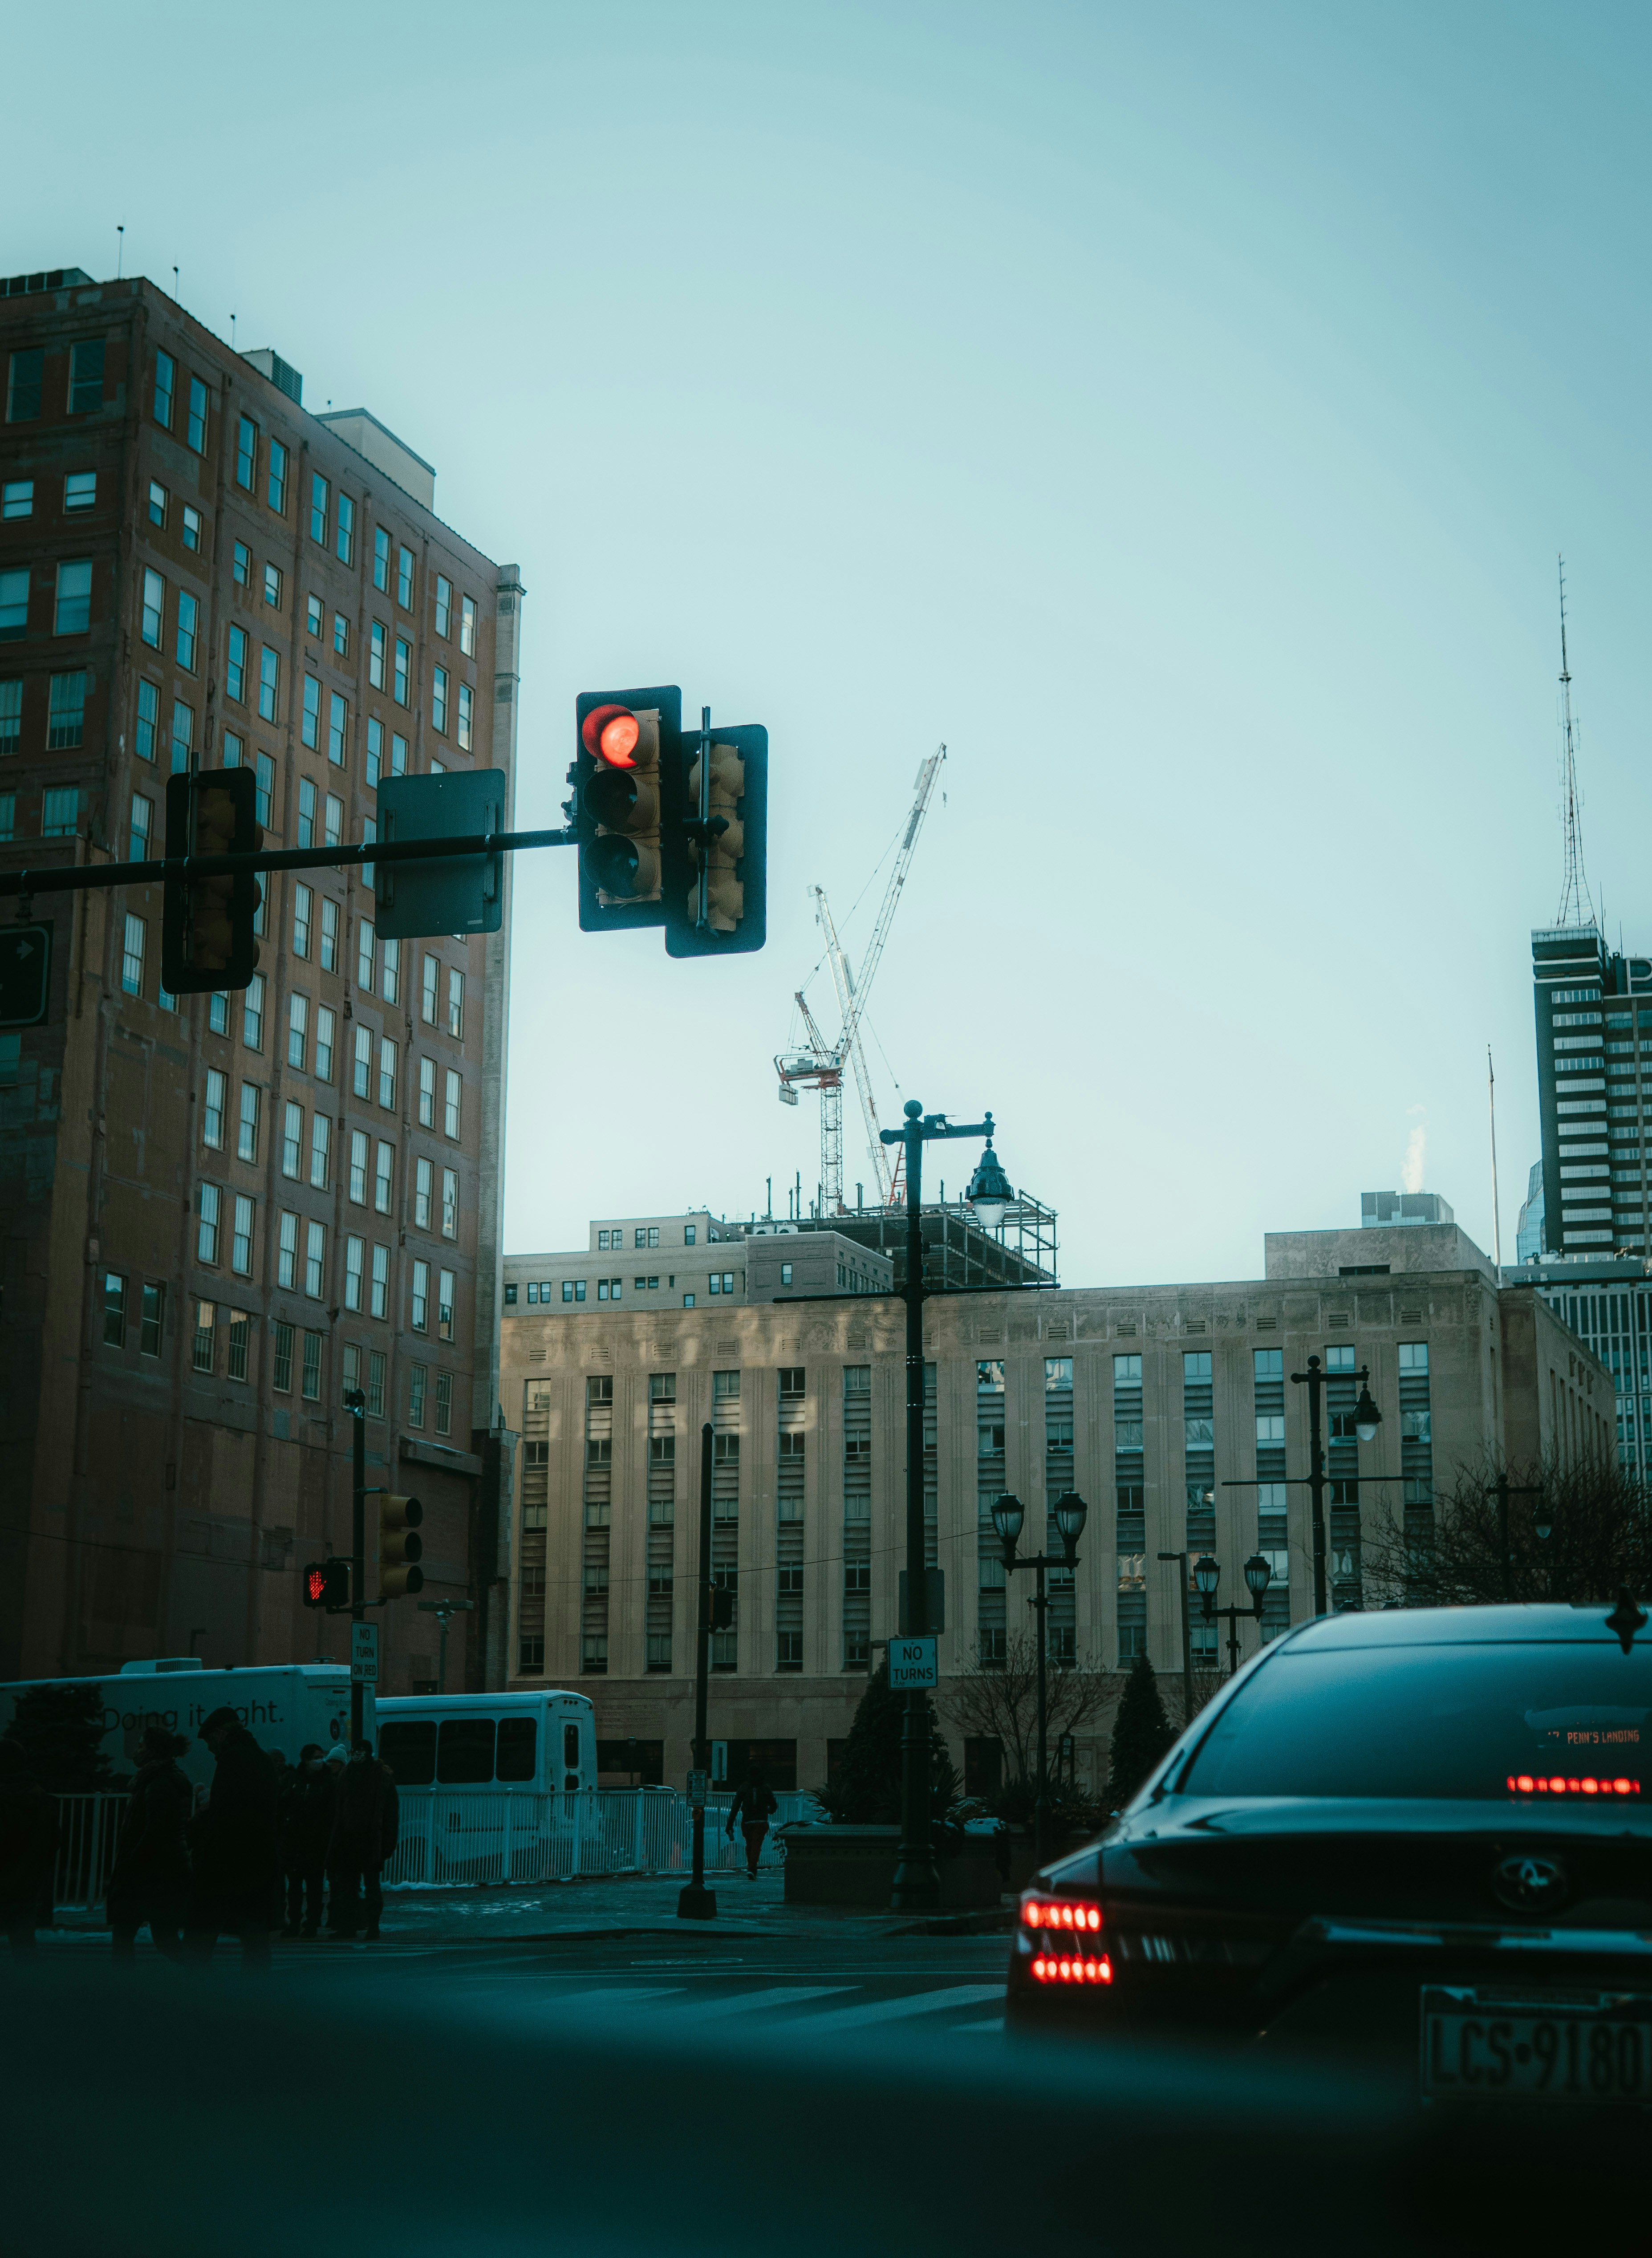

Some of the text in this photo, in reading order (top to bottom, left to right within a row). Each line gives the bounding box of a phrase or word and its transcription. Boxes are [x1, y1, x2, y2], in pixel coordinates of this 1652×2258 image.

[1626, 958, 1652, 995] P
[360, 1629, 370, 1640] NO
[355, 1646, 374, 1658] TURN
[903, 1646, 922, 1661] NO
[353, 1664, 376, 1677] ON RED
[893, 1668, 934, 1680] TURNS
[102, 1698, 284, 1732] Doing it ght.
[1567, 1731, 1599, 1745] PENN'S
[1602, 1729, 1640, 1743] LANDING
